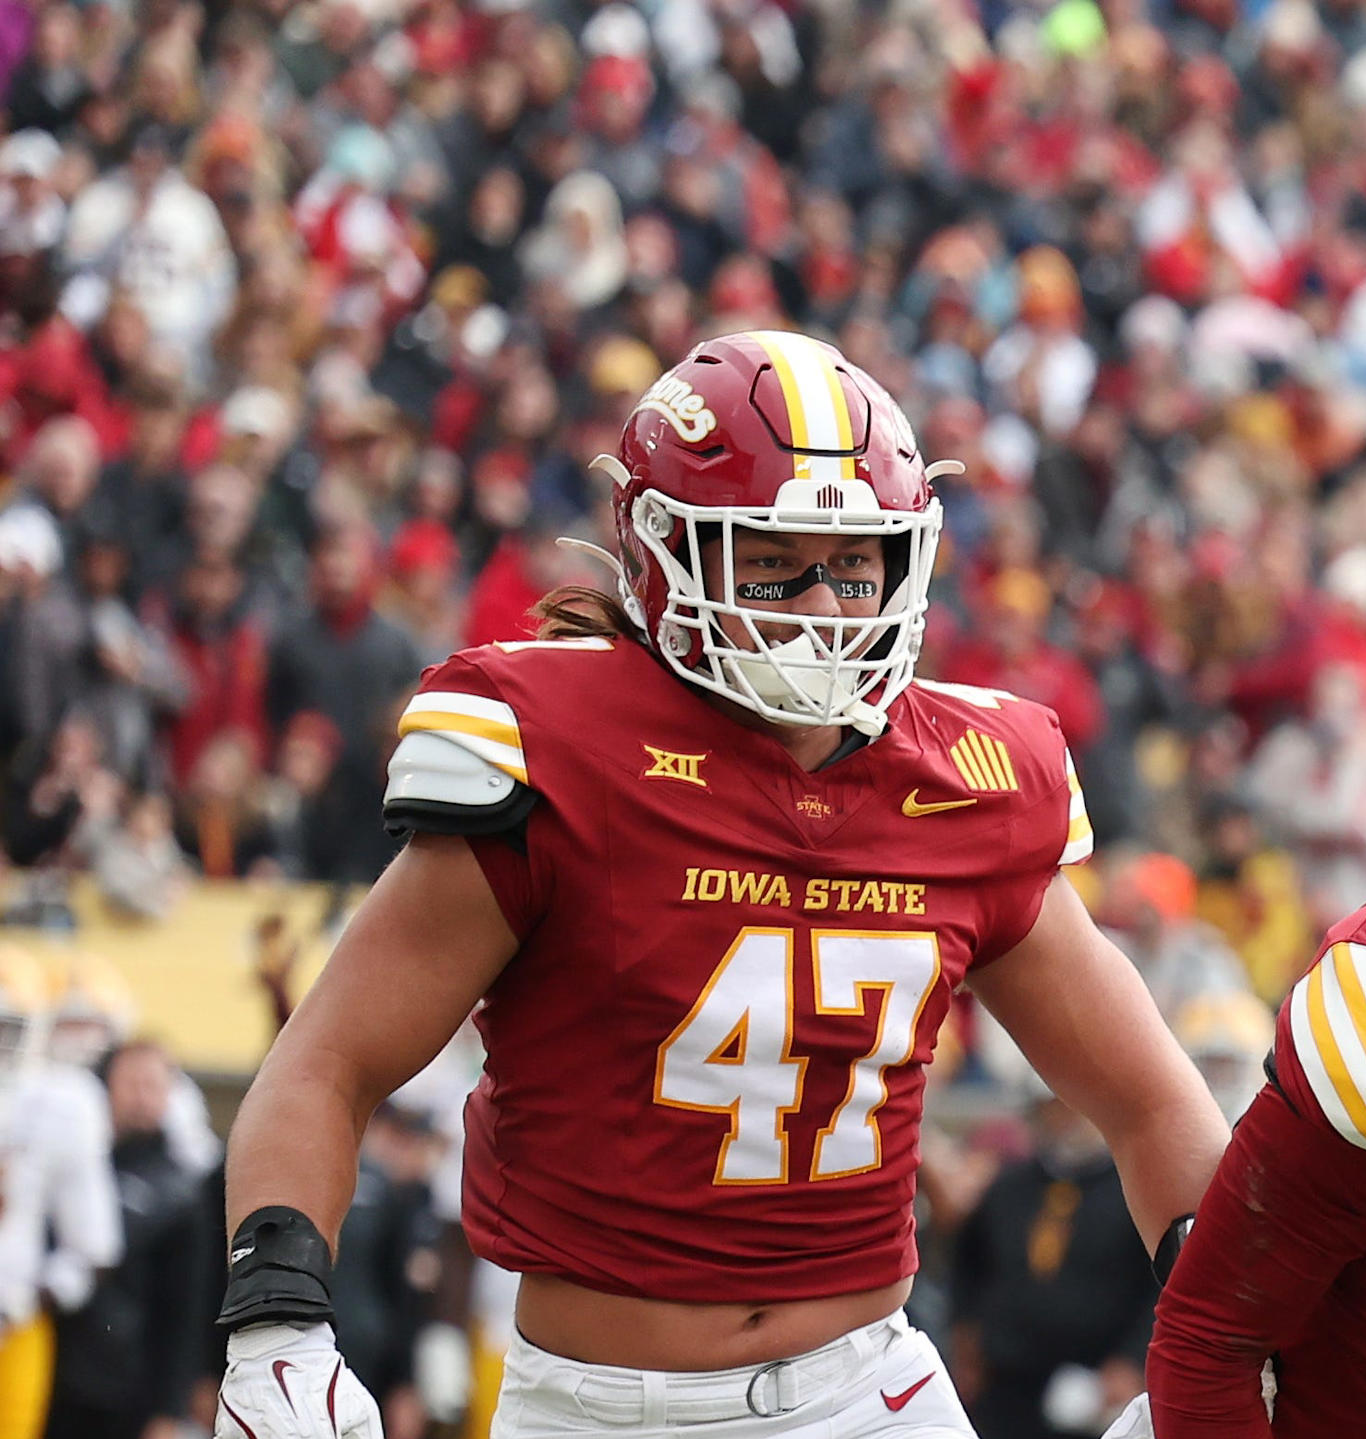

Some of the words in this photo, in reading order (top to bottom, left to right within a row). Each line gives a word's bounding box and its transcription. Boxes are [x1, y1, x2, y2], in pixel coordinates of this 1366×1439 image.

[744, 583, 783, 599] JOHN
[841, 583, 873, 598] 15:13
[642, 743, 708, 788] XII
[682, 867, 791, 907] IOWA
[803, 878, 926, 915] STATE
[653, 926, 941, 1185] 47
